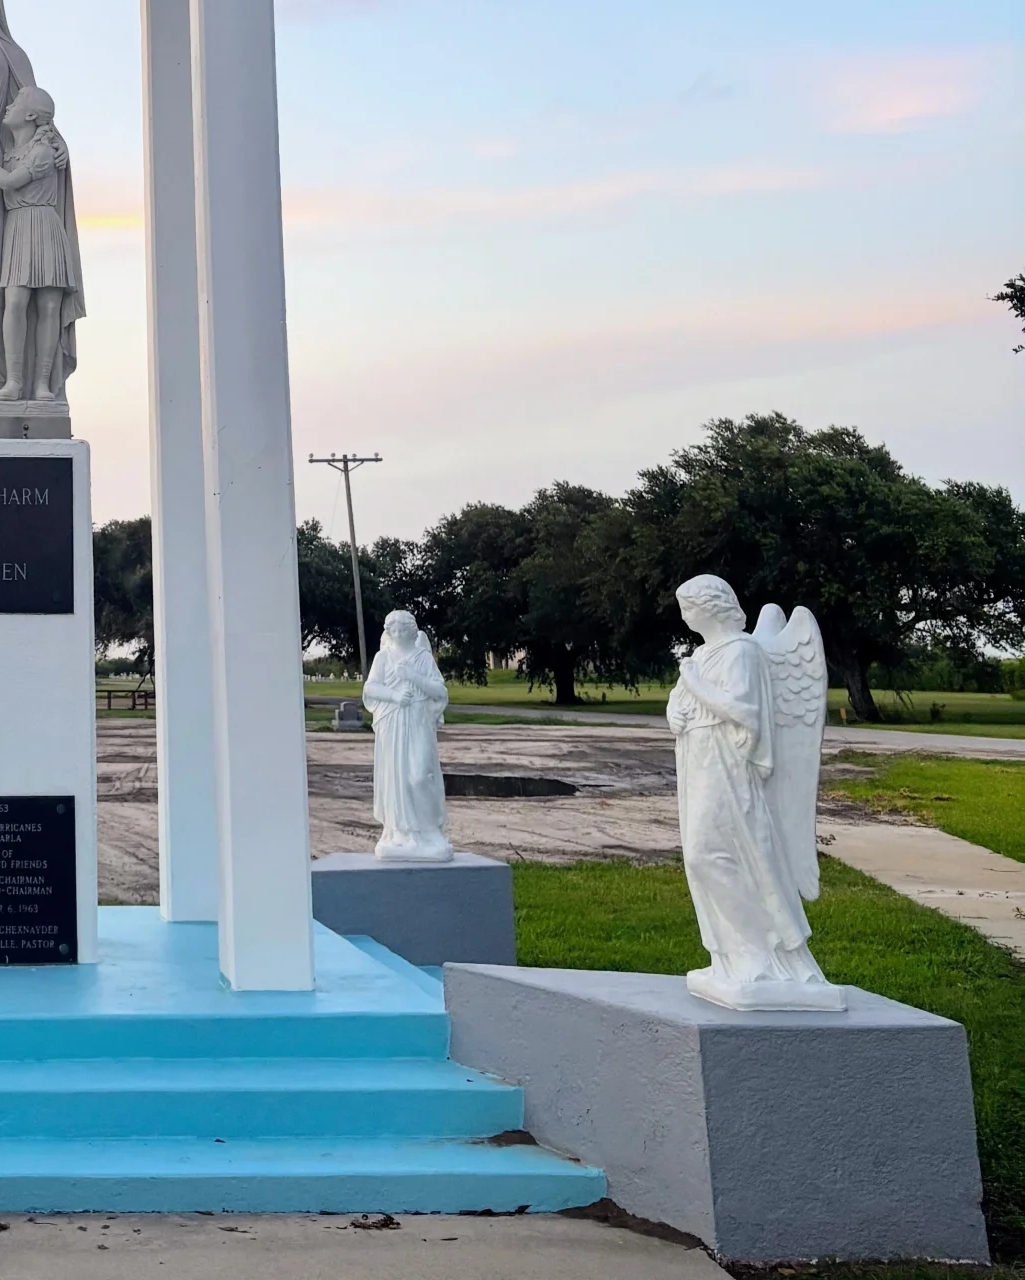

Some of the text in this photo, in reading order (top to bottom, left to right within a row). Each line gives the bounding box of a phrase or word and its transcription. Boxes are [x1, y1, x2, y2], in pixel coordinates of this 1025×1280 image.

[1, 849, 14, 859] OF
[10, 860, 48, 869] FRIENDS
[18, 904, 39, 914] 1963
[21, 940, 55, 949] PASTOR
